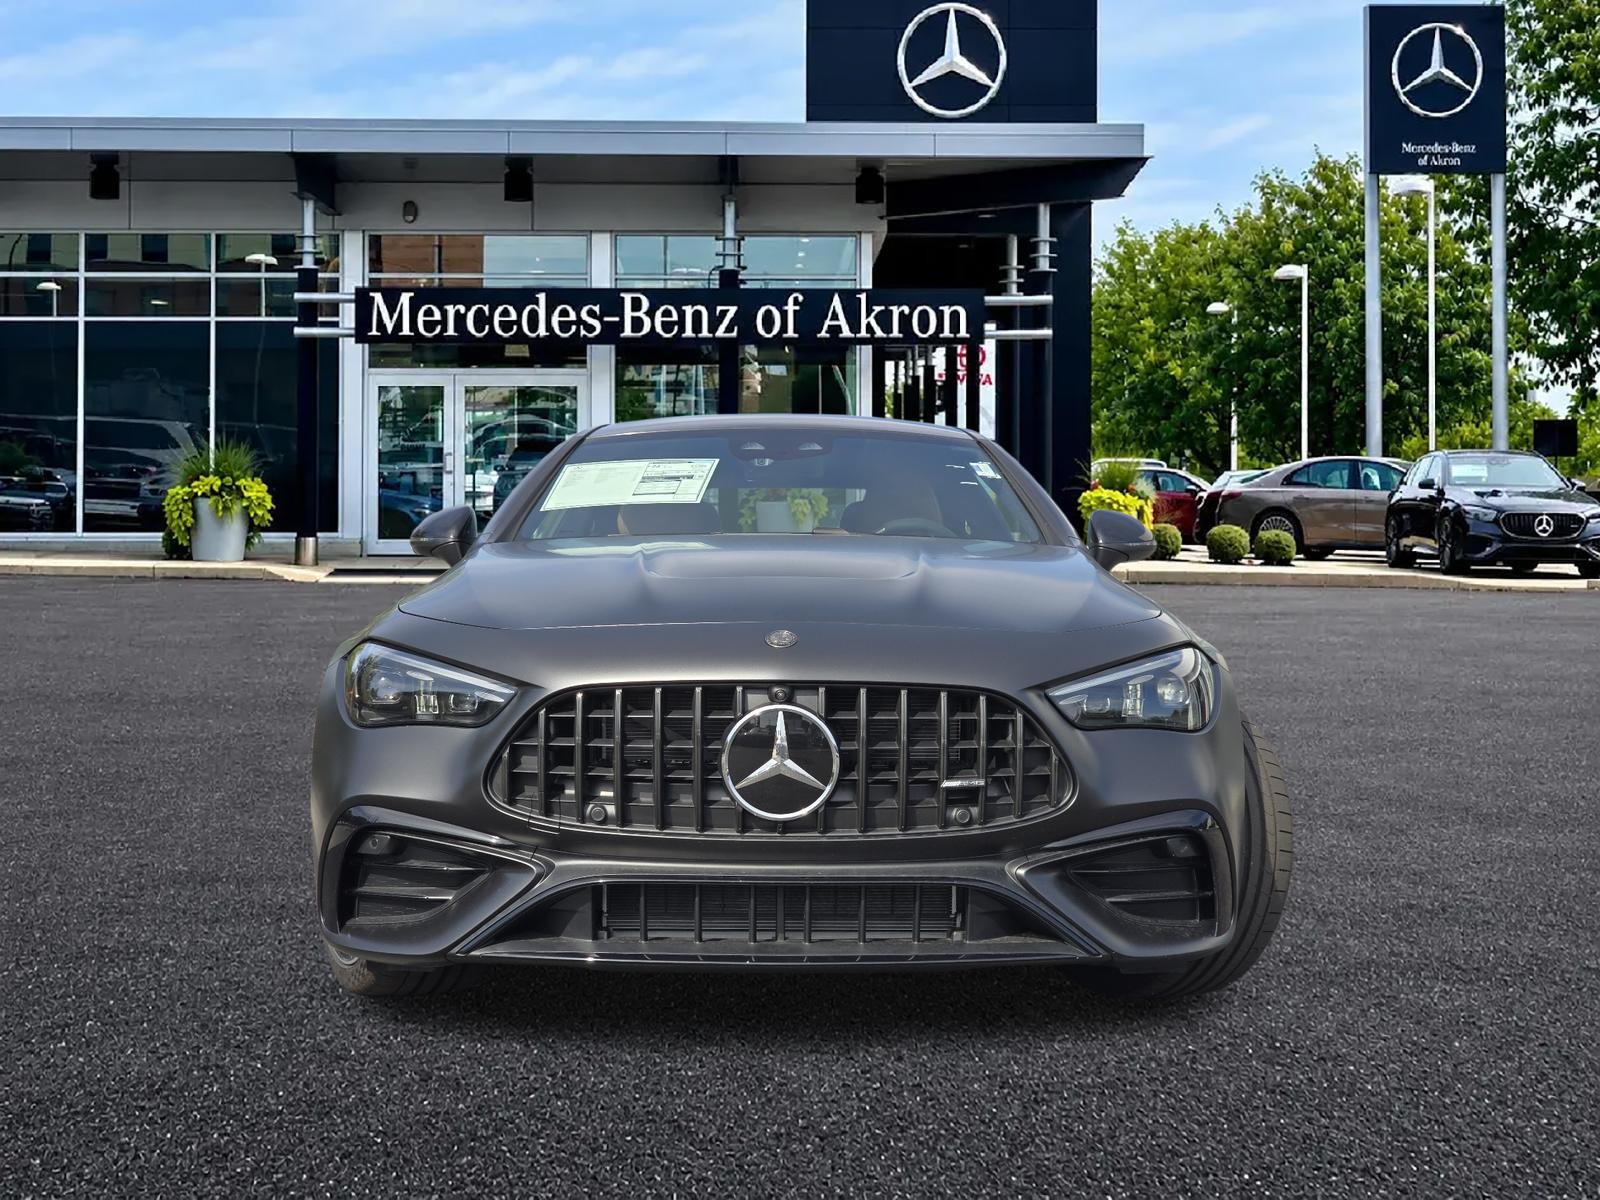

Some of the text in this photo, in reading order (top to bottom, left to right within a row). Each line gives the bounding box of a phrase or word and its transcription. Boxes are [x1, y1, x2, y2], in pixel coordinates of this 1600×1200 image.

[1401, 142, 1476, 153] Mercedes-Benz
[1418, 154, 1461, 165] of Akron
[367, 291, 970, 339] Mercedes-Benz of Akron
